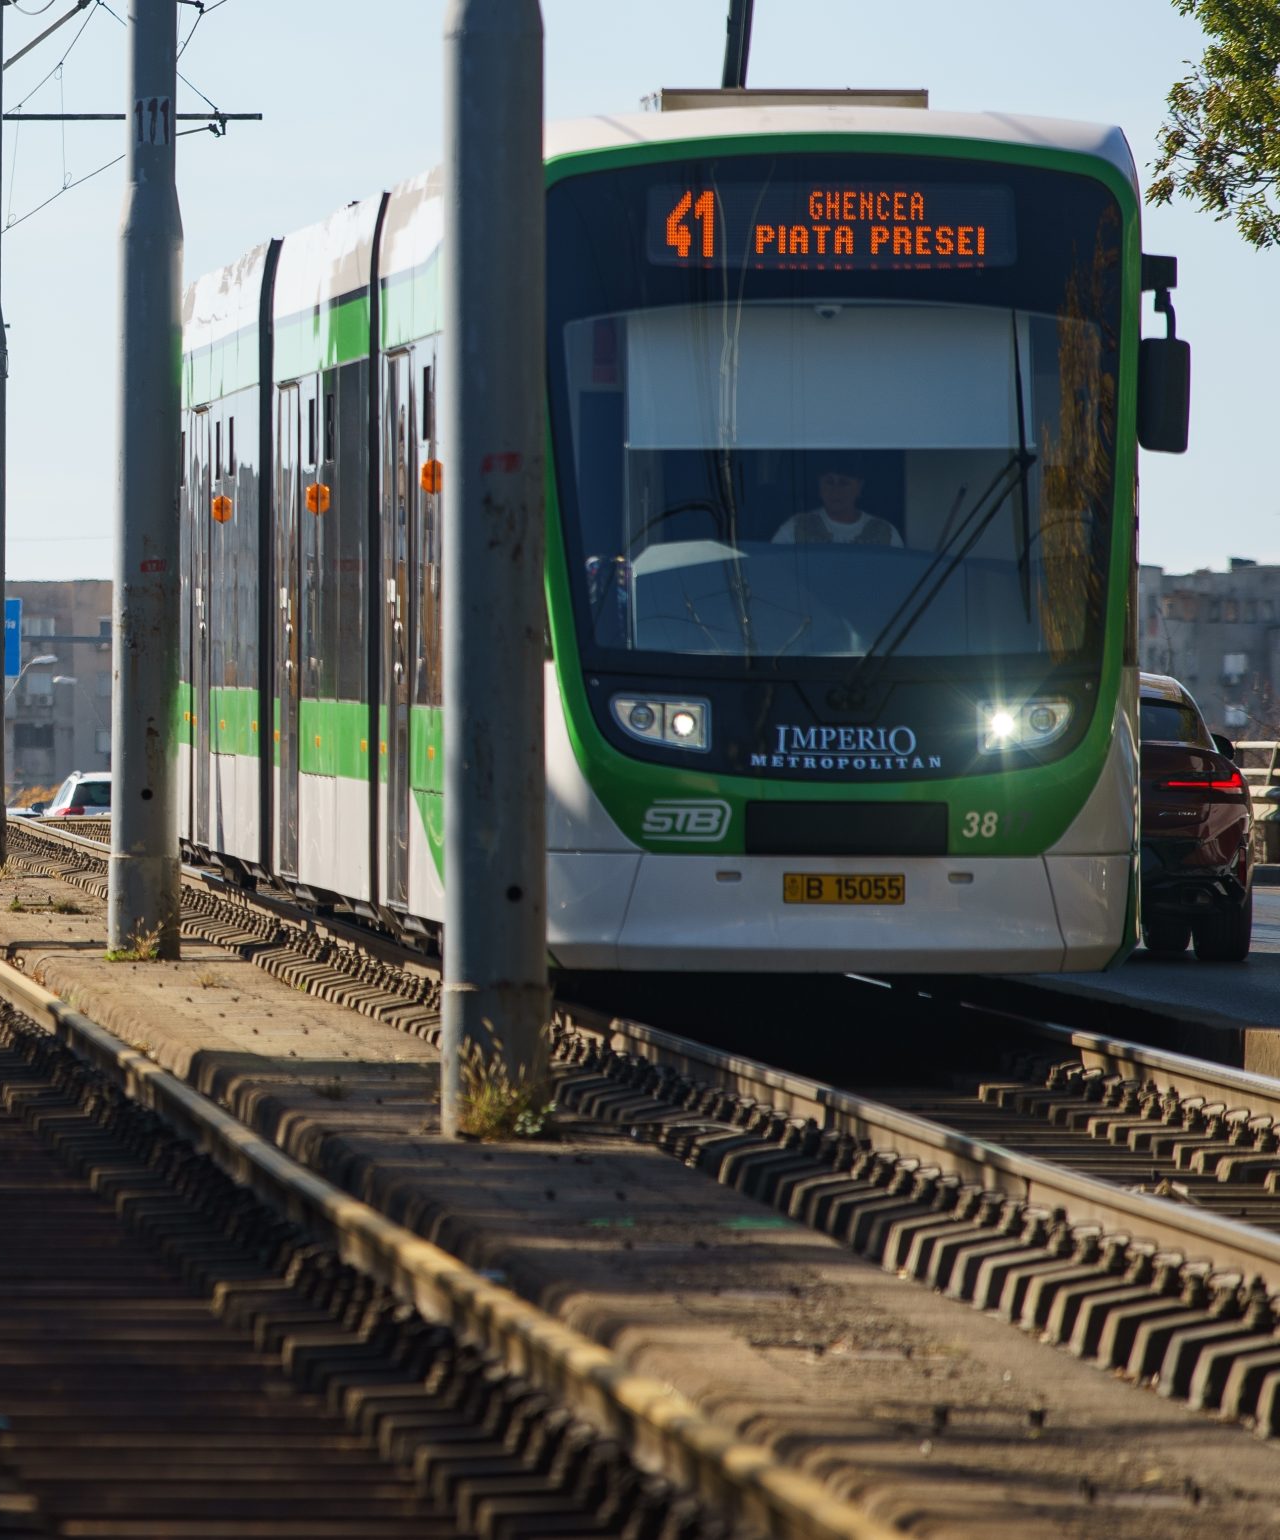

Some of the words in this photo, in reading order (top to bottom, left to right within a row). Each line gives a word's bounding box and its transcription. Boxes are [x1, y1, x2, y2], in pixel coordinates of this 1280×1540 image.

[134, 97, 170, 145] 111
[809, 191, 924, 220] GHENCEA
[666, 190, 714, 258] 41
[755, 225, 854, 254] PIATA
[871, 225, 985, 255] PRESEI
[776, 724, 917, 755] IMPERIO
[750, 753, 942, 769] METROPOLITAN
[642, 807, 722, 834] STB
[806, 877, 823, 899] B
[835, 877, 902, 900] 15055
